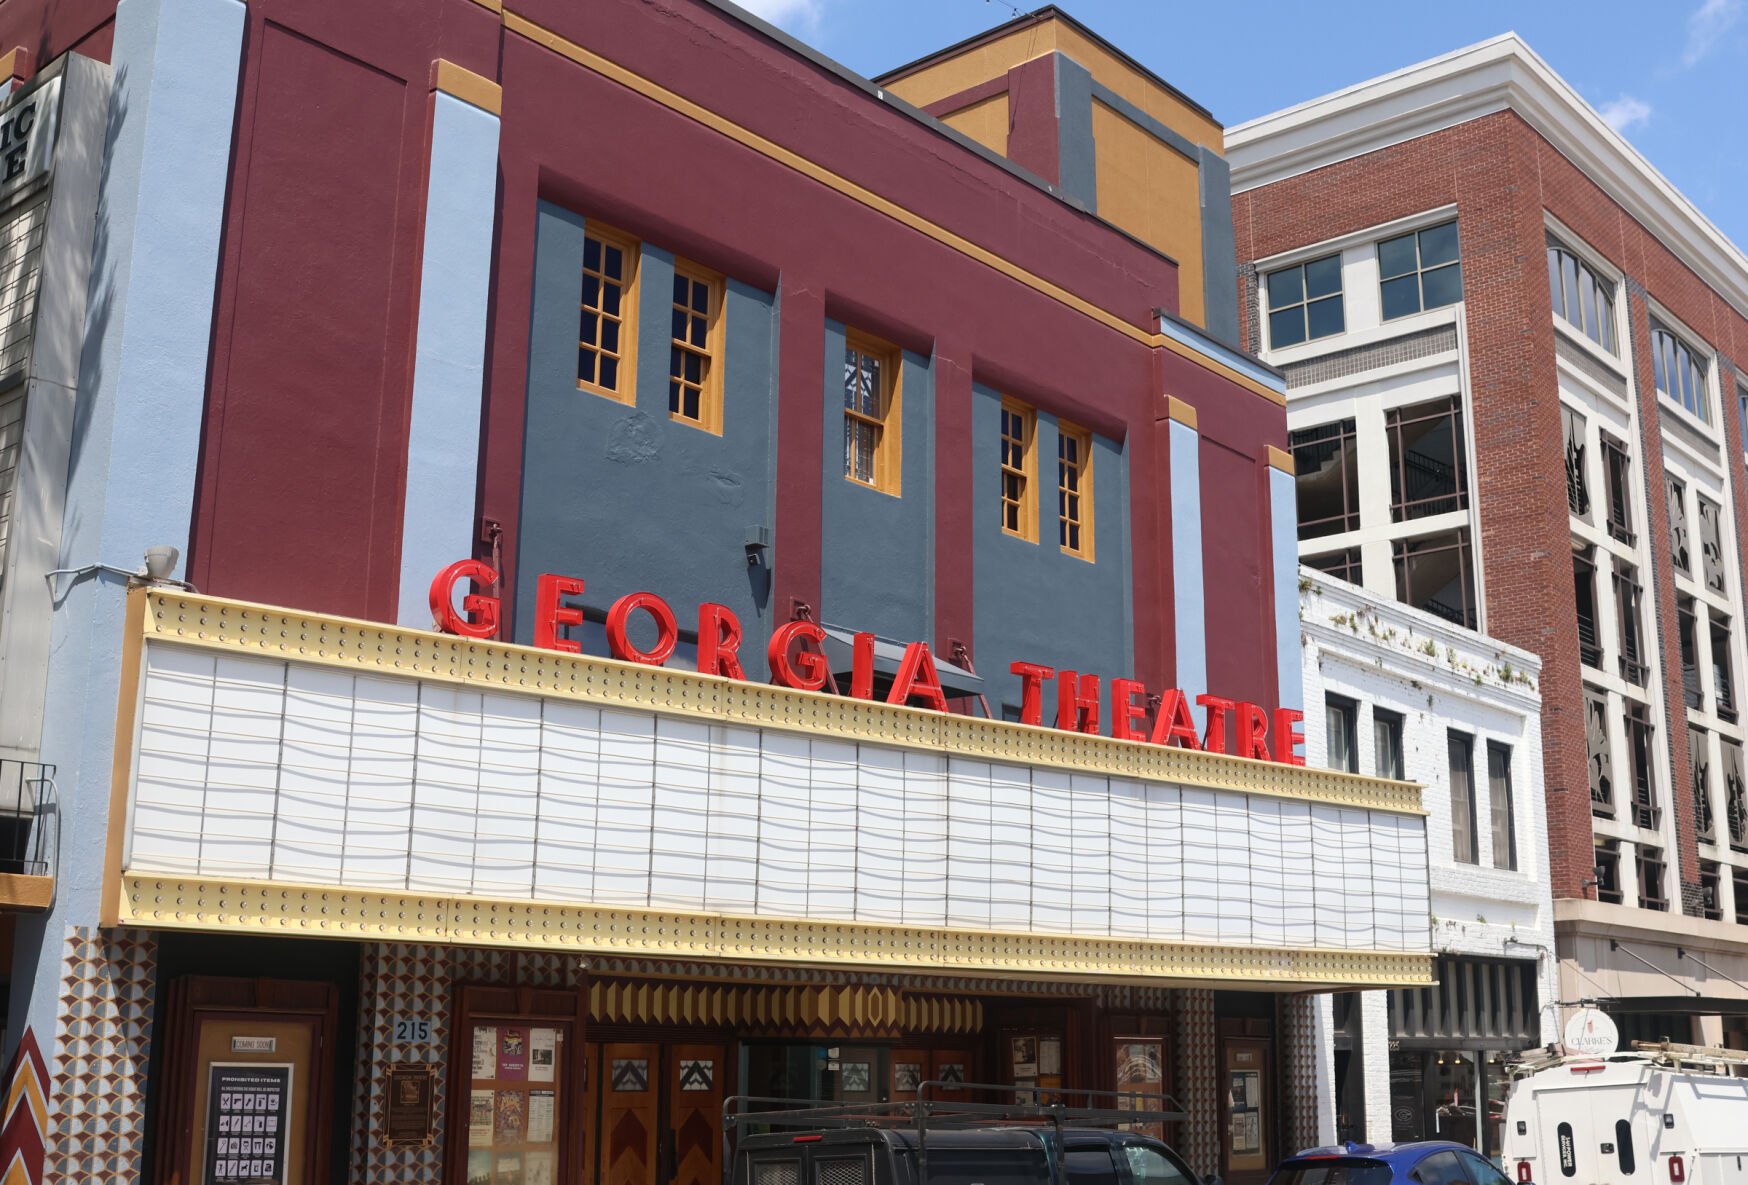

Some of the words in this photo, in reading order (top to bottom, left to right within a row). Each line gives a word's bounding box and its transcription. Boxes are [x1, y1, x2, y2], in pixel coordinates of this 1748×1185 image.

[429, 559, 949, 712] GEORGIA
[1010, 661, 1306, 768] THEATRE
[396, 1021, 429, 1040] 215
